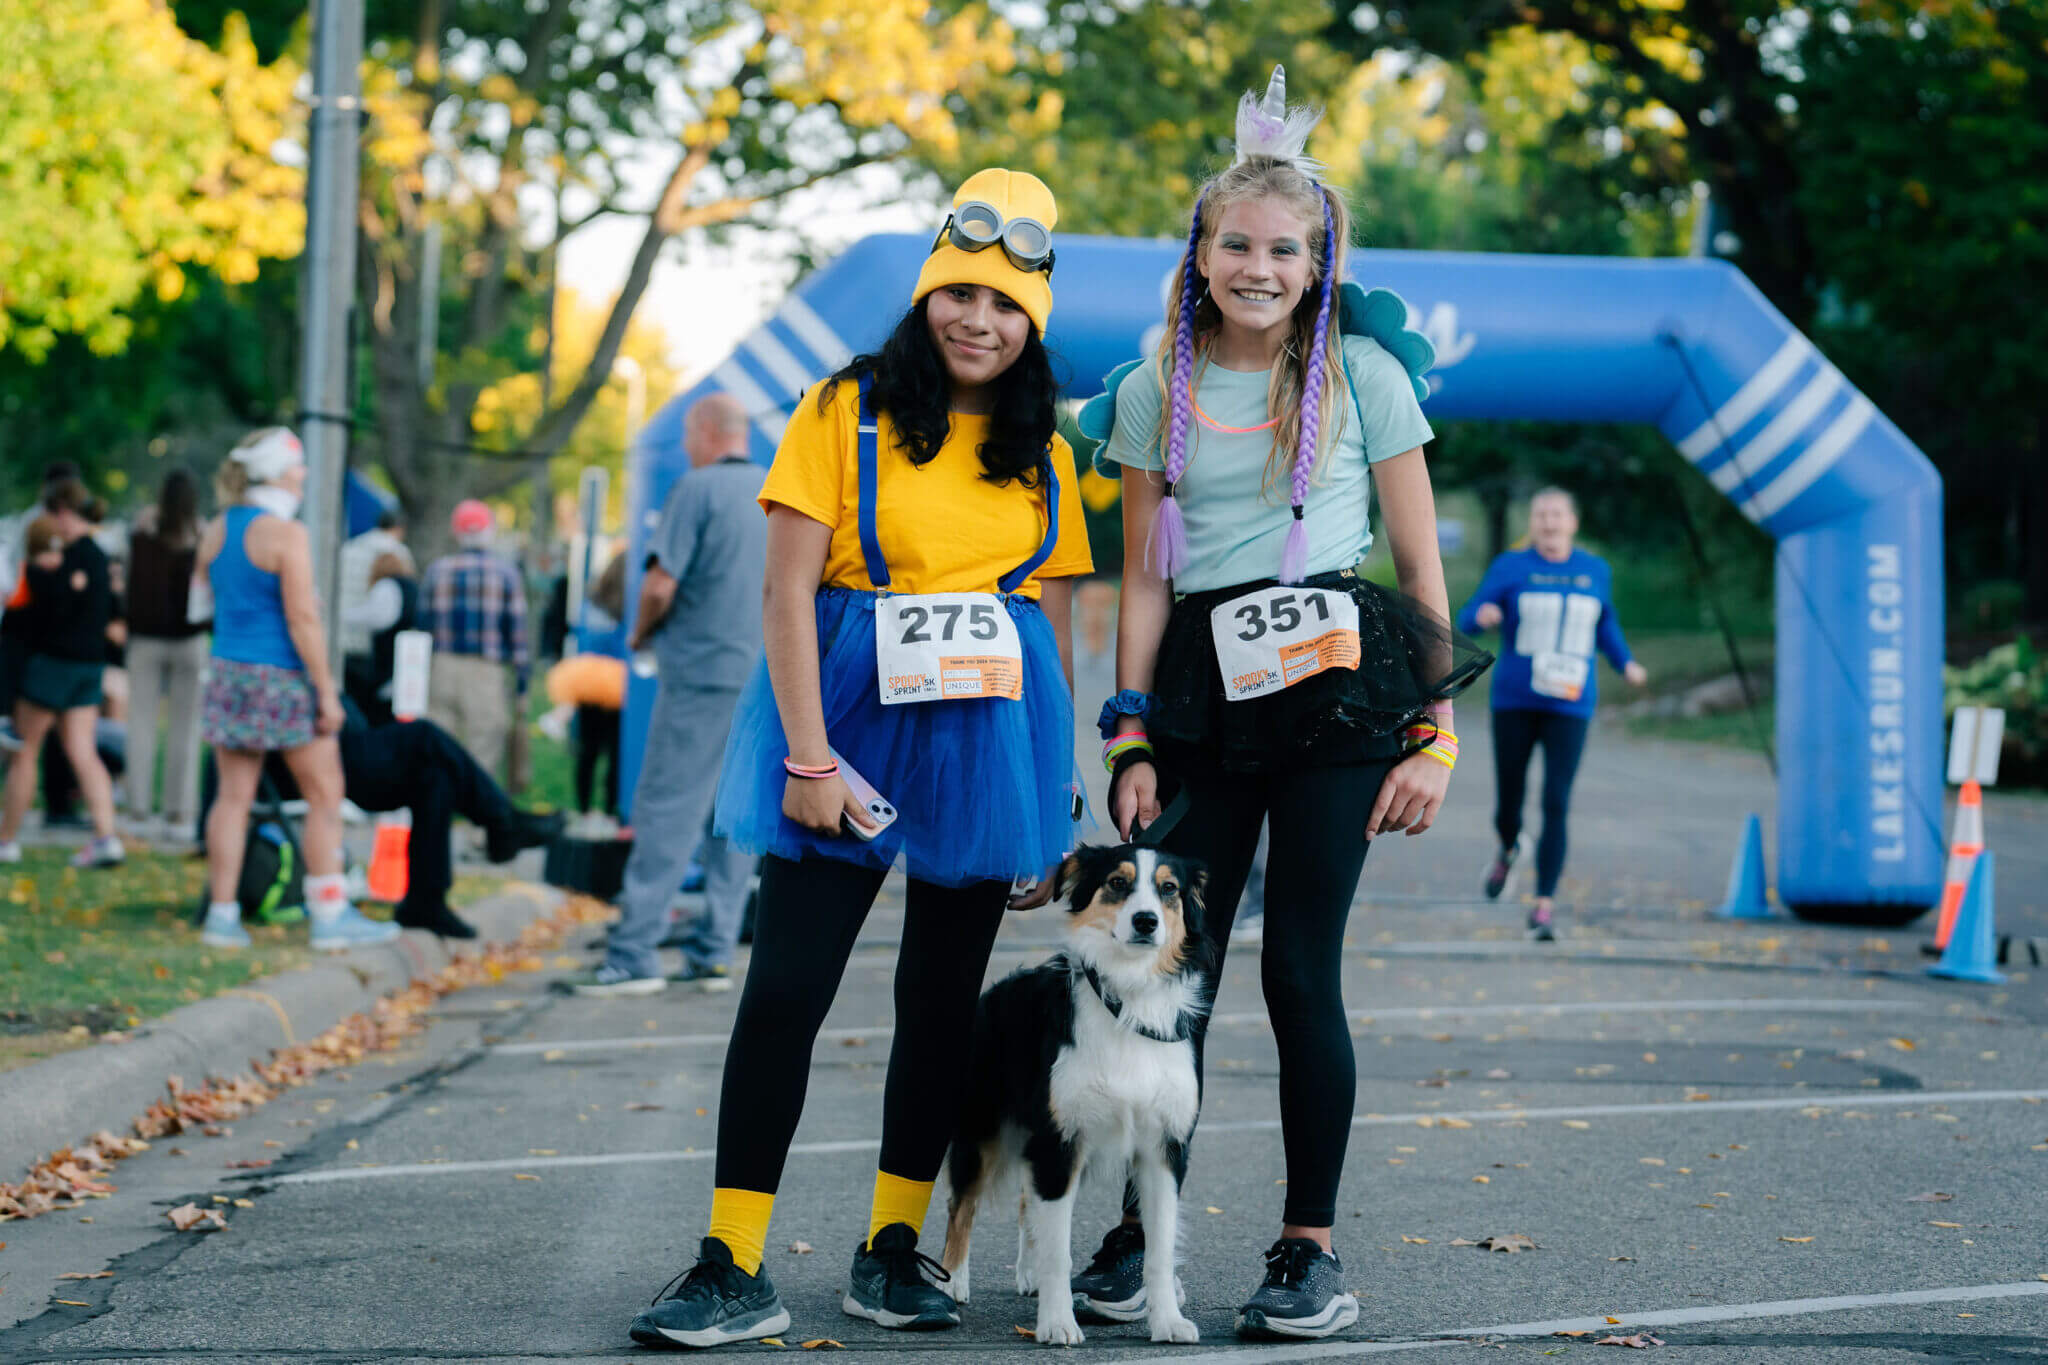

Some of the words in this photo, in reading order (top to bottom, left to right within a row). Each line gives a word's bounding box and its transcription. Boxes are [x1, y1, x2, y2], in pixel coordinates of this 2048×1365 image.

[899, 604, 999, 645] 275
[1234, 592, 1330, 642] 351
[1287, 659, 1318, 679] UNIQUE
[888, 673, 927, 689] SPOOKY
[924, 678, 936, 686] 5K
[945, 681, 981, 690] UNIQUE
[1232, 669, 1269, 690] SPOOKY
[1267, 671, 1278, 680] 5K
[1239, 680, 1265, 695] SPRINT
[894, 685, 921, 696] SPRINT
[1867, 544, 1906, 863] LAKESRUN.COM
